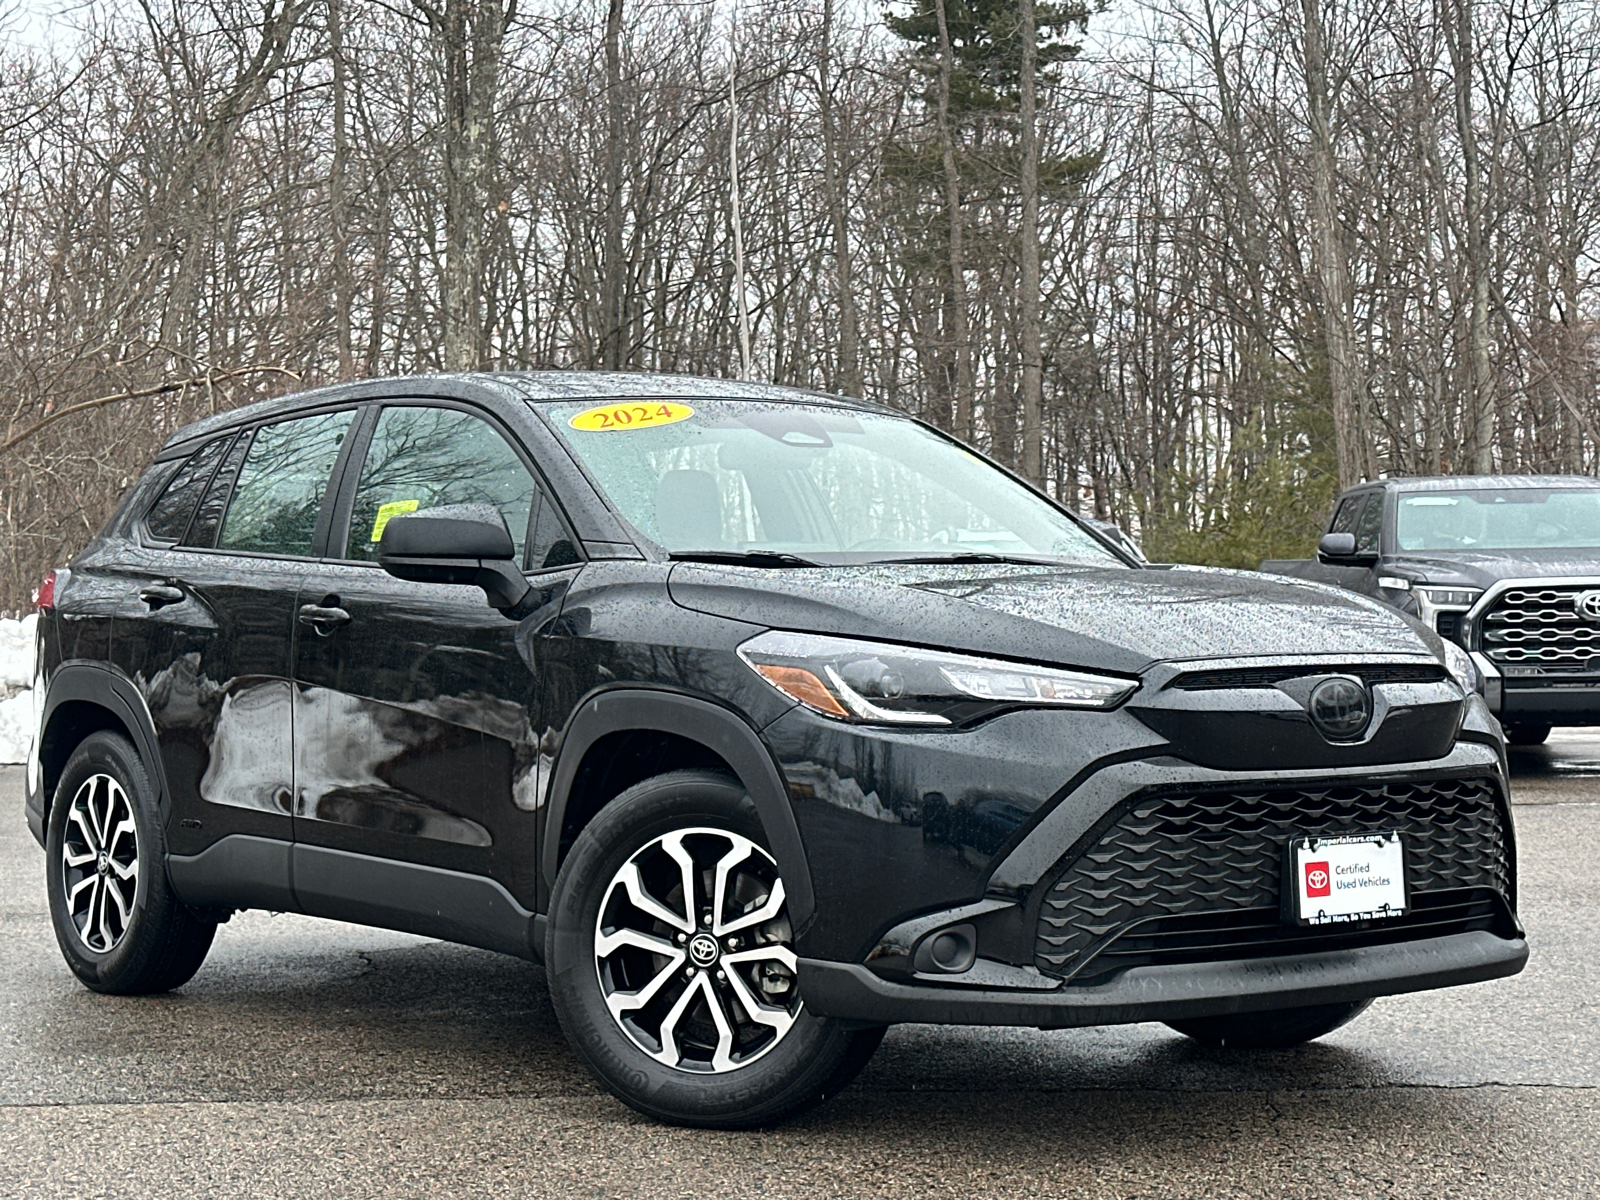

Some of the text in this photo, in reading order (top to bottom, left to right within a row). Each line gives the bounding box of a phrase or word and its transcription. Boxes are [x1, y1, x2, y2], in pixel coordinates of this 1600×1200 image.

[592, 404, 673, 429] 2024
[1335, 862, 1371, 876] Certified
[1336, 875, 1391, 891] Used Vehicles
[1309, 908, 1403, 926] We Sell More, So You Save More
